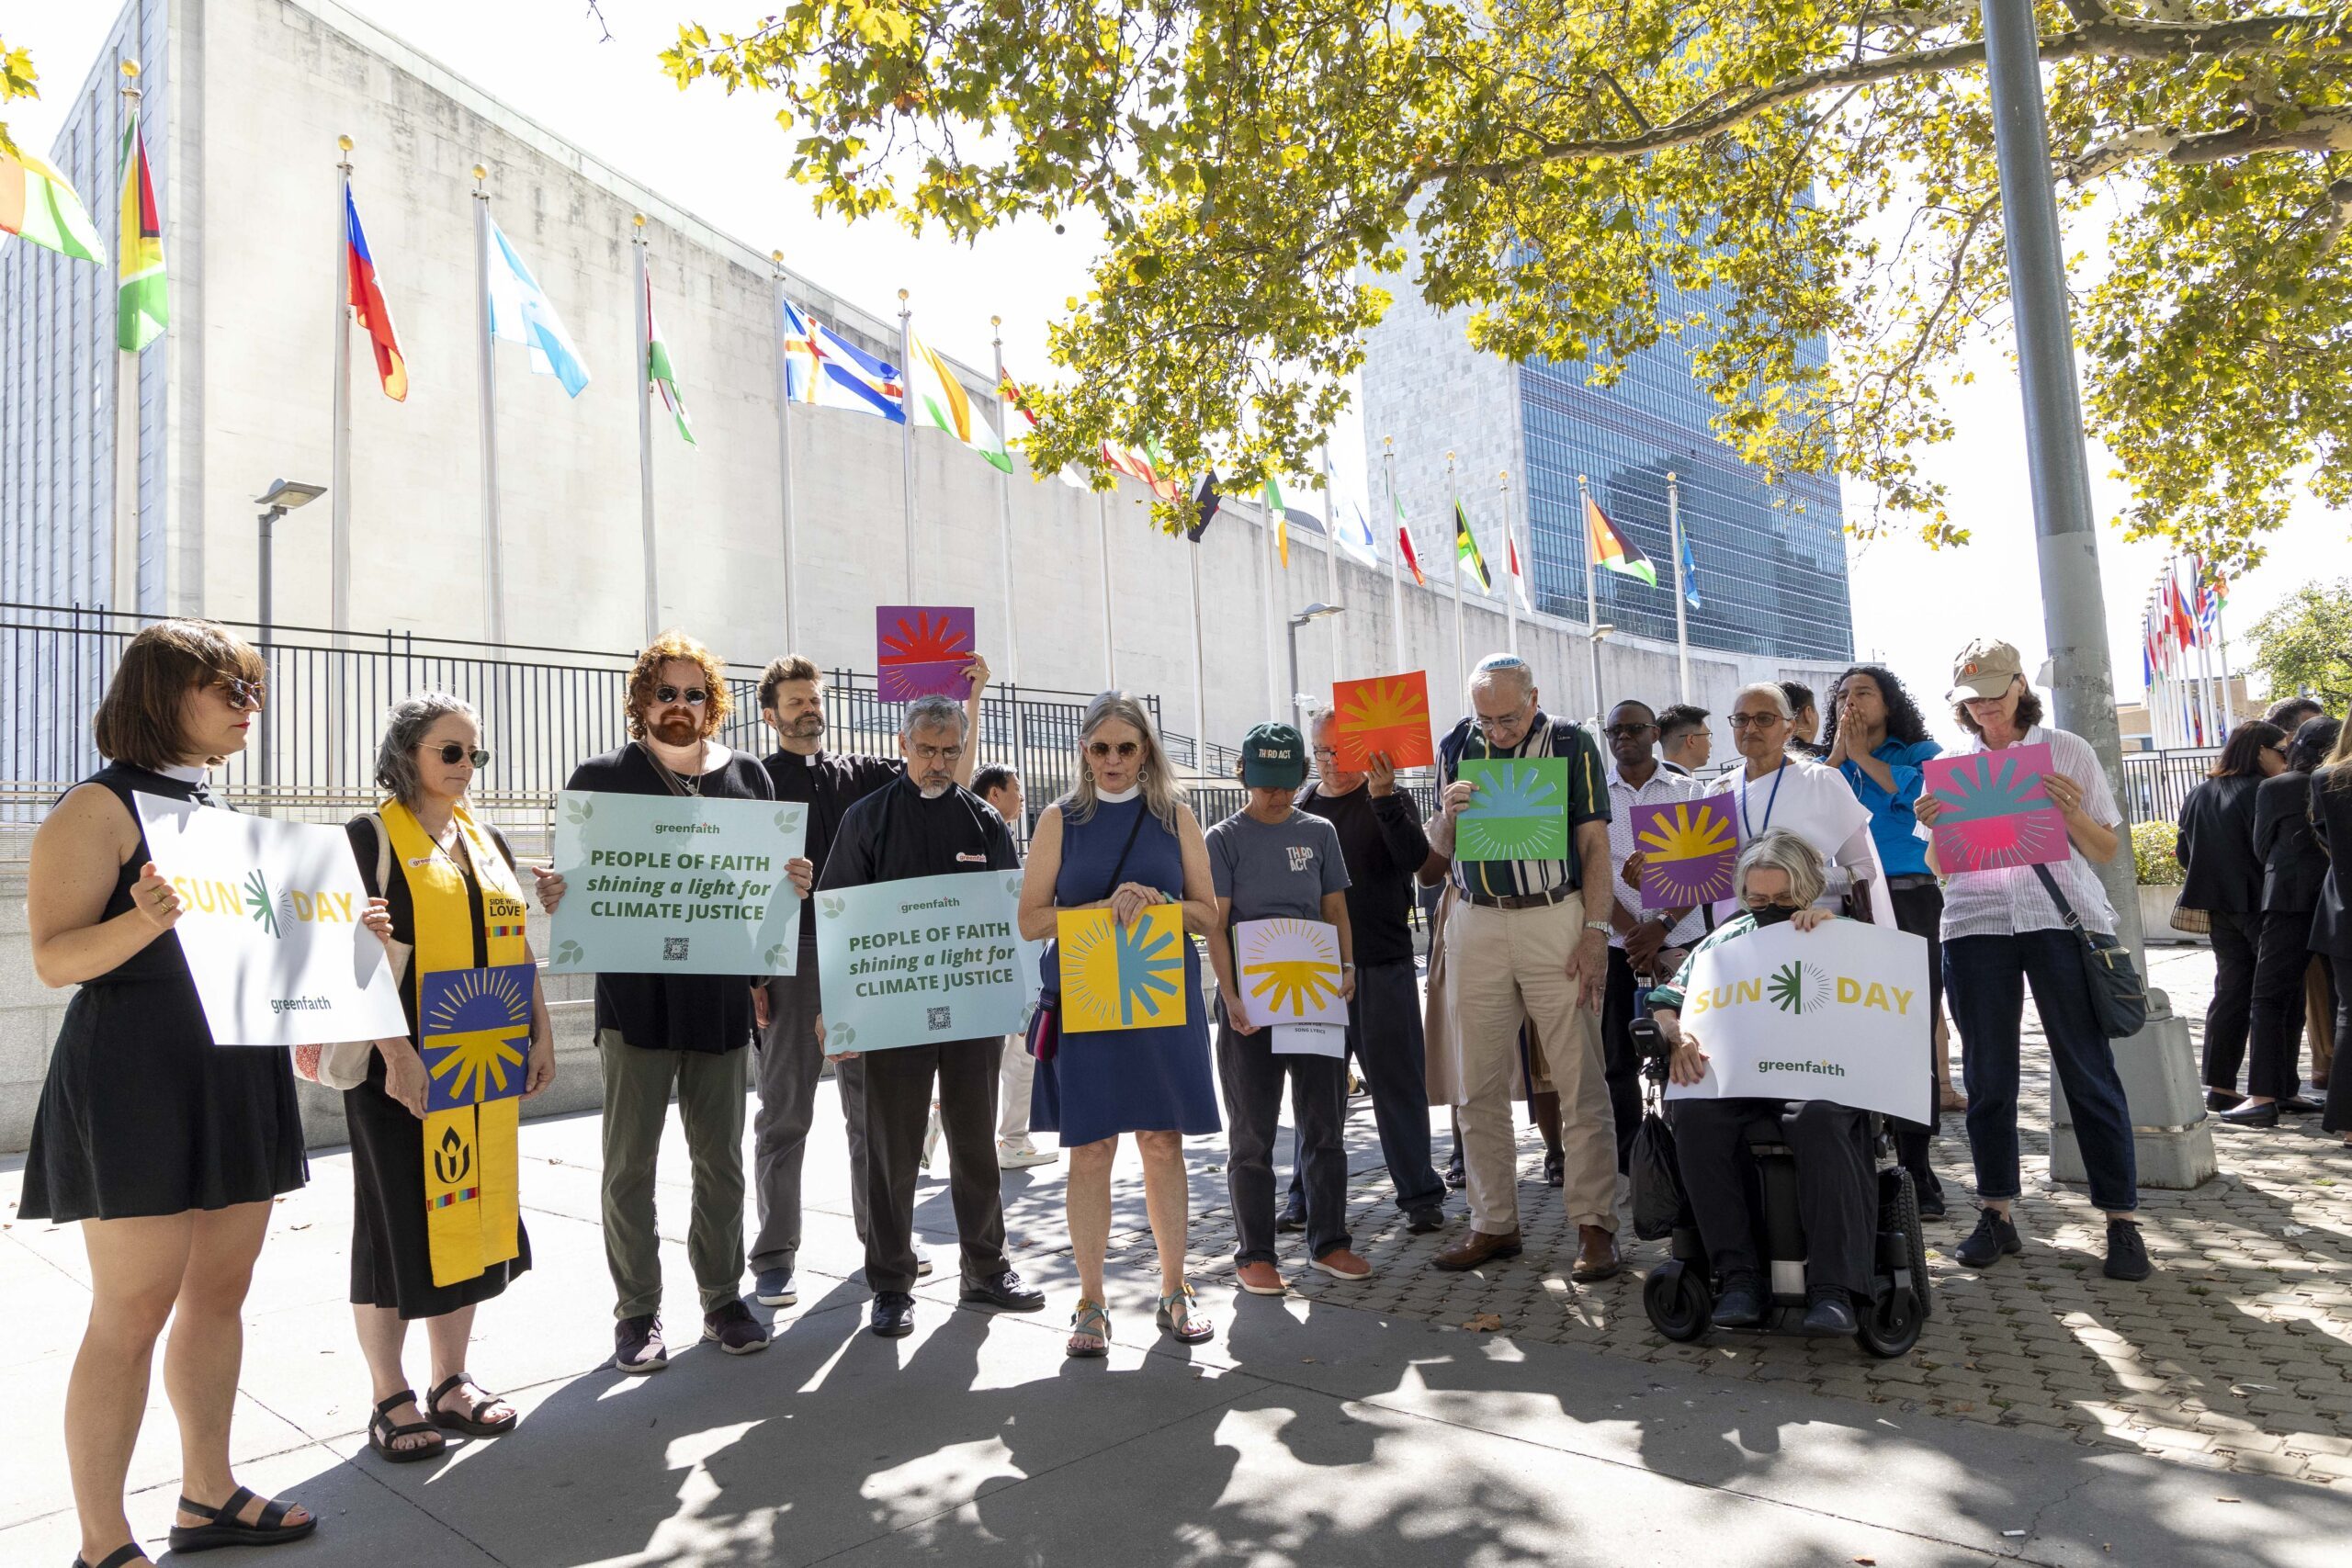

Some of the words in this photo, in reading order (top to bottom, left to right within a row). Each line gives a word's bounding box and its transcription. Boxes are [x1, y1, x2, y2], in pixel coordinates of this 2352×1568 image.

[1258, 749, 1278, 759] THIRD
[1278, 750, 1291, 759] ACT
[655, 822, 720, 834] greenfaith
[591, 850, 672, 869] PEOPLE
[677, 853, 705, 869] OF
[710, 854, 770, 872] FAITH
[1285, 845, 1314, 859] THIRD
[1289, 858, 1307, 872] ACT
[586, 875, 665, 898] shining
[670, 882, 683, 894] a
[687, 878, 736, 899] light
[738, 880, 771, 899] for
[174, 876, 243, 916] SUN
[290, 889, 353, 923] DAY
[900, 897, 960, 913] greenfaith
[490, 905, 521, 917] LOVE
[590, 901, 683, 919] CLIMATE
[684, 904, 764, 923] JUSTICE
[849, 930, 922, 952] PEOPLE
[925, 926, 951, 942] OF
[956, 921, 1011, 940] FAITH
[849, 955, 920, 976] shining
[923, 953, 935, 966] a
[940, 948, 983, 968] light
[987, 945, 1015, 965] for
[855, 975, 939, 998] CLIMATE
[942, 968, 1014, 992] JUSTICE
[270, 996, 332, 1014] greenfaith
[1693, 976, 1761, 1014] SUN
[1837, 976, 1914, 1015] DAY
[1758, 1059, 1846, 1077] greenfaith
